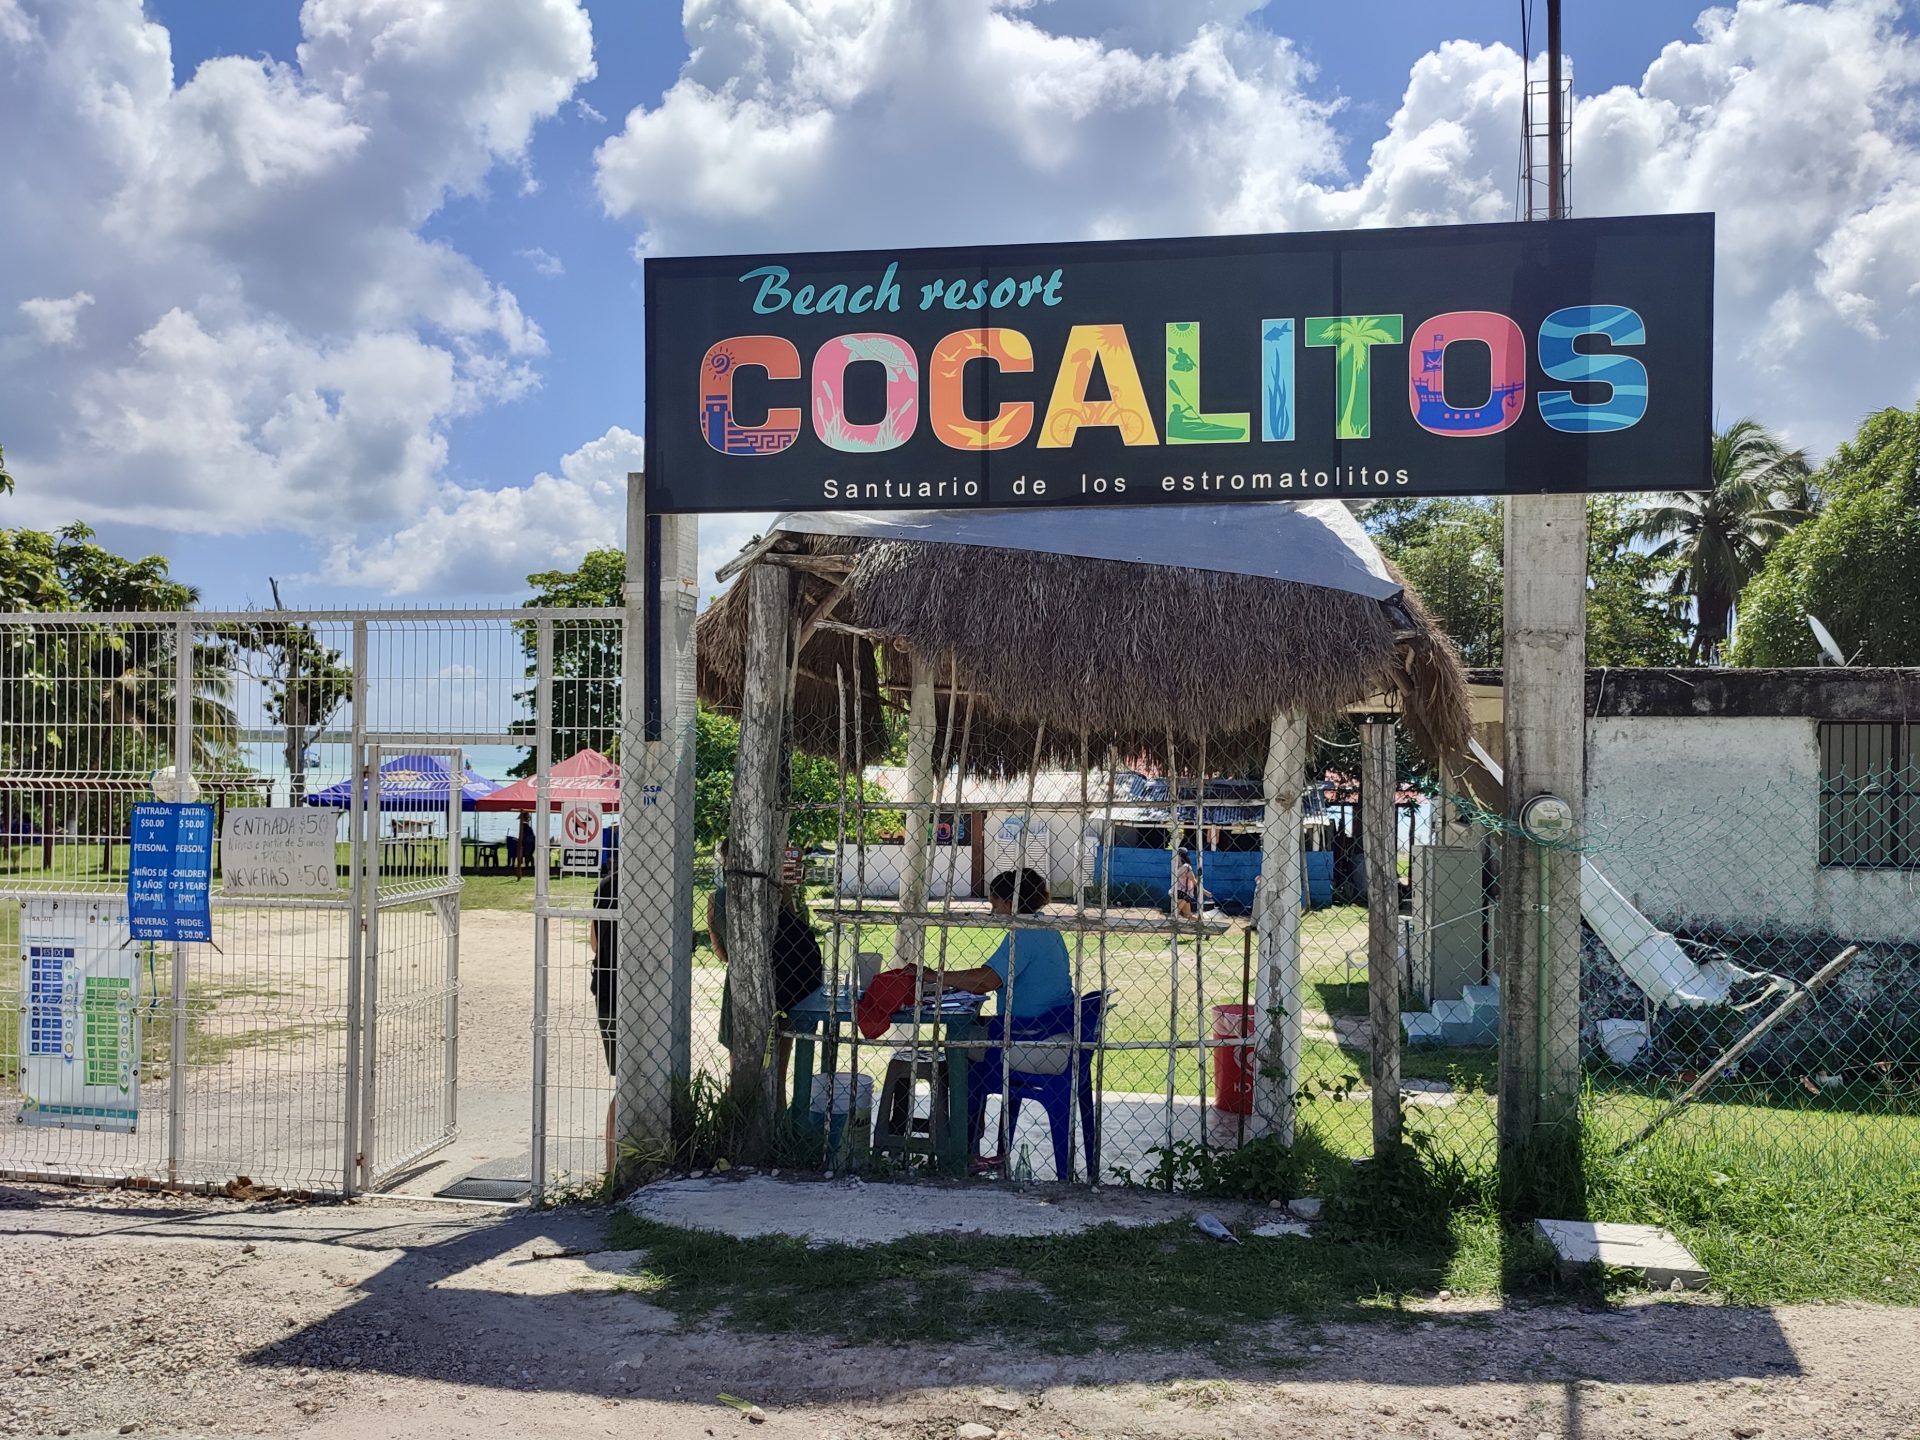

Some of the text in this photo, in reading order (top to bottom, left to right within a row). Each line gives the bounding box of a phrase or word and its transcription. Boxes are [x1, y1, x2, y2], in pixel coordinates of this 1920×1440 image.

[739, 261, 1064, 315] Beach resort
[698, 303, 1649, 457] COCALITOS
[823, 466, 1410, 499] Santuario de los estromatolitos
[179, 807, 206, 816] -ENTRY:
[141, 819, 165, 828] $50.00
[233, 815, 295, 836] ENTRADA
[134, 844, 169, 852] PERSONA.
[175, 845, 205, 853] PERSON.
[158, 869, 168, 877] DE
[170, 870, 207, 878] -CHILDREN
[227, 867, 289, 887] NEVERAS
[142, 879, 163, 889] AÑOS
[185, 882, 207, 890] YEARS
[134, 893, 163, 903] (PAGAN)
[178, 894, 196, 904] (PAY)
[132, 917, 169, 926] -NEVERAS:
[174, 918, 204, 927] -FRIDGE:
[139, 929, 162, 937] $50.00
